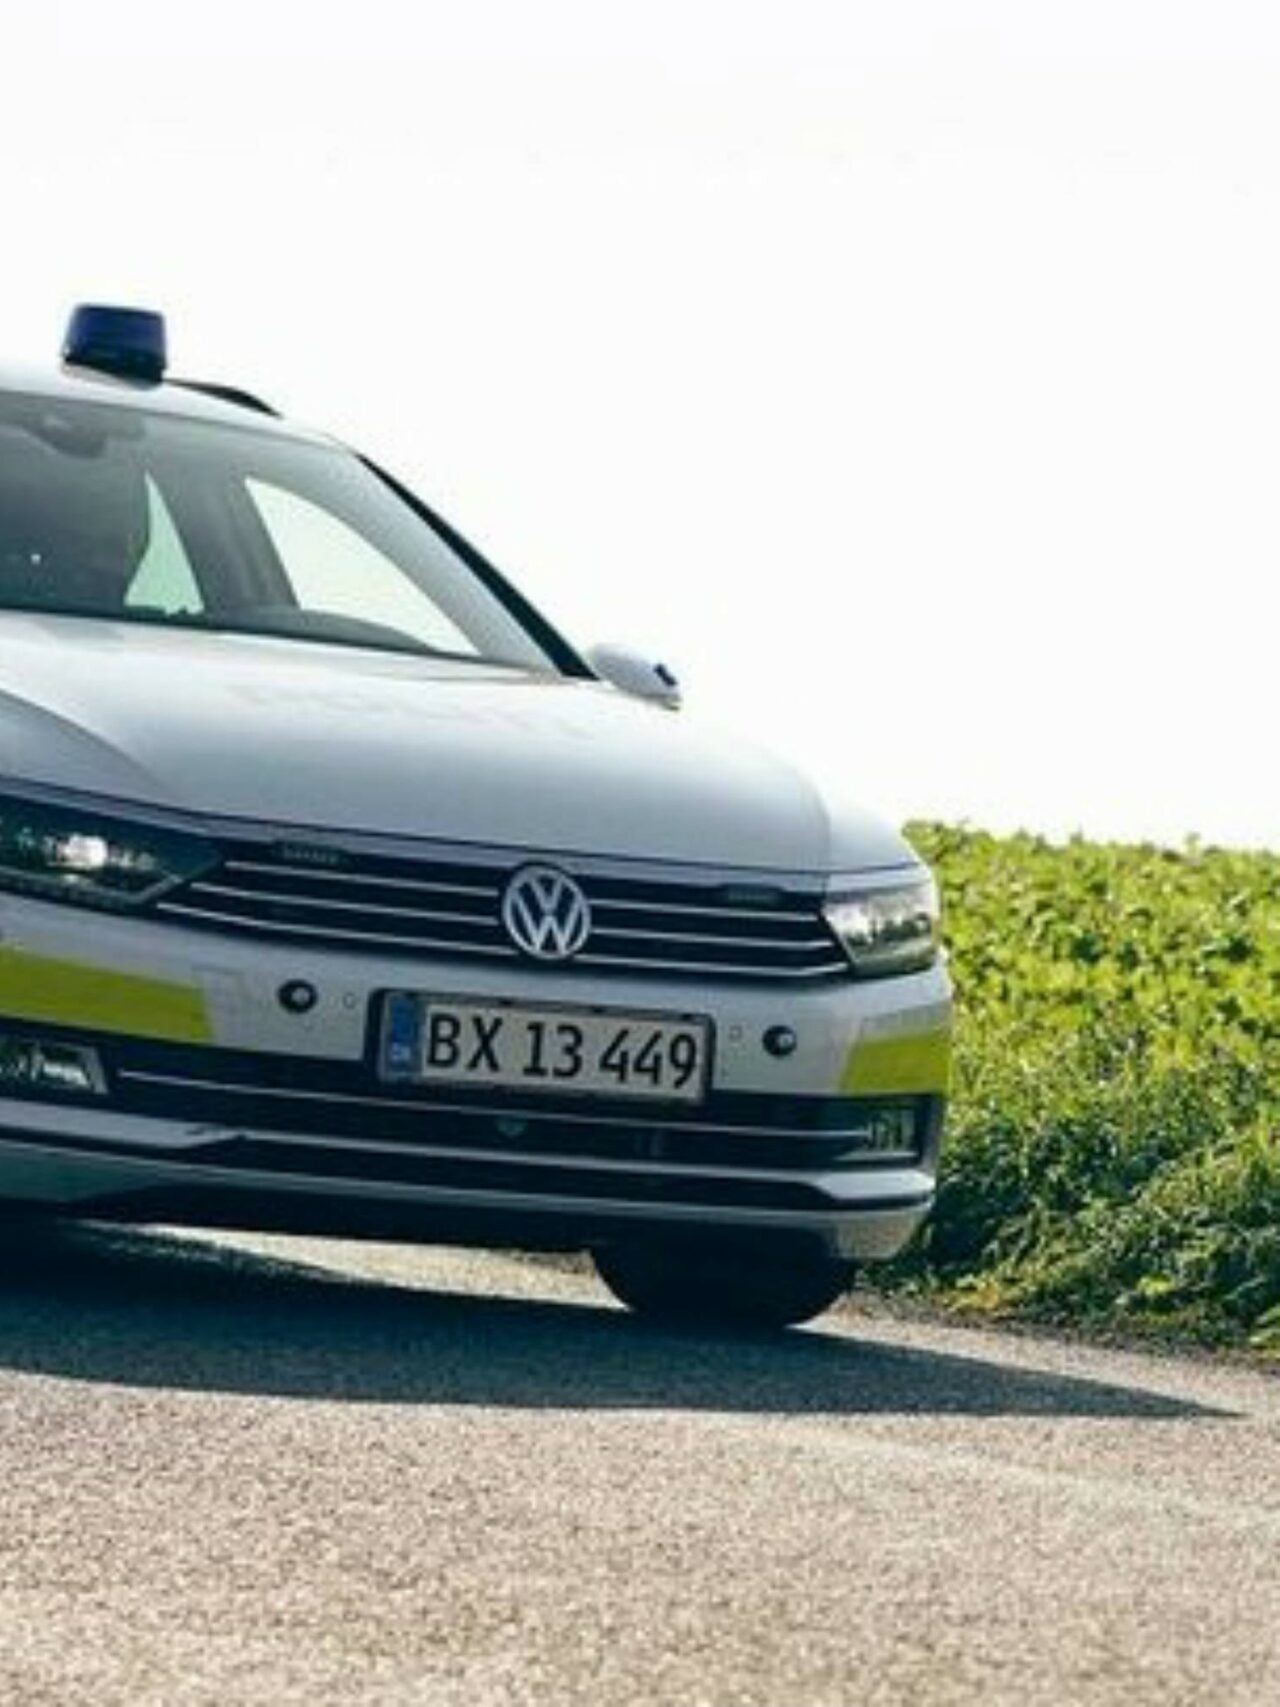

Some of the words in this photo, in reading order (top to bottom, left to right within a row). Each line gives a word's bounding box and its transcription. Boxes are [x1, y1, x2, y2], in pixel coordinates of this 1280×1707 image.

[505, 867, 591, 958] VW
[427, 1013, 503, 1072] BX
[522, 1022, 583, 1078] 13
[599, 1030, 697, 1089] 449
